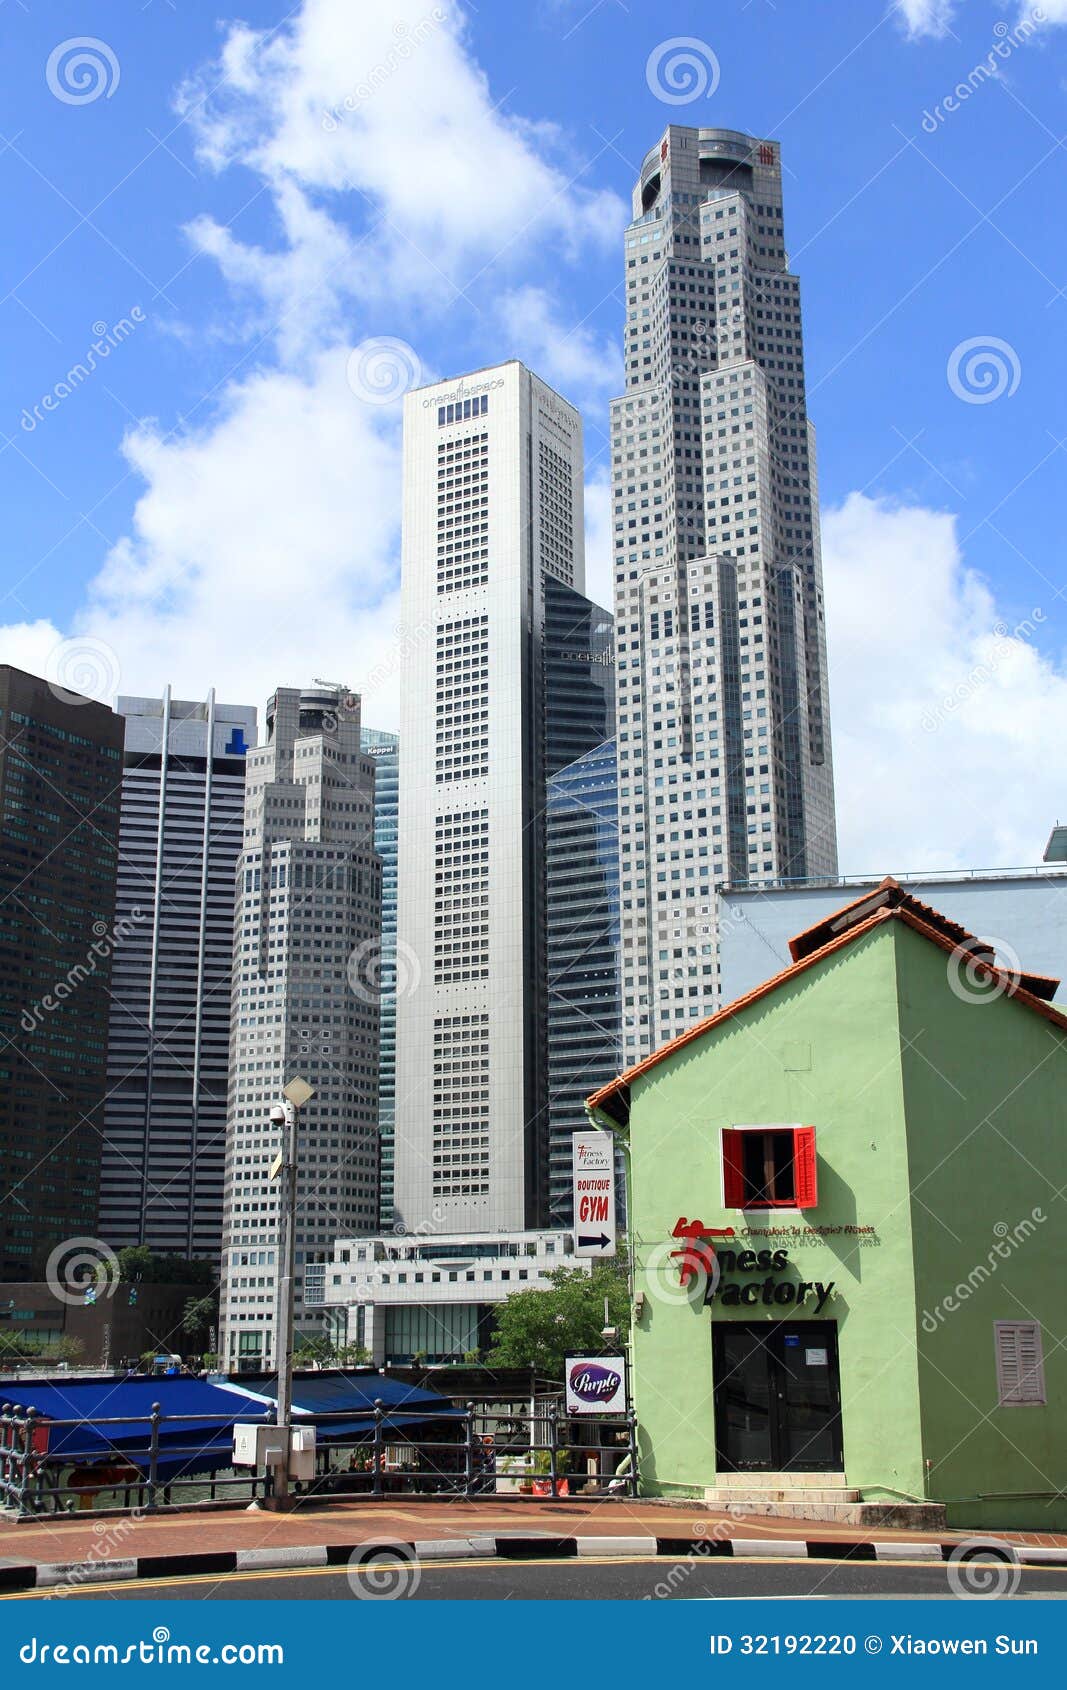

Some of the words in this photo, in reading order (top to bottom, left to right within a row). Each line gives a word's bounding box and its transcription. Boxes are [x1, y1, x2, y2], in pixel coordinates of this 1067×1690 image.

[368, 746, 393, 755] Keppel
[578, 1180, 610, 1191] BOUTIQUE
[579, 1195, 609, 1223] GYM
[703, 1274, 836, 1315] Factory
[574, 1371, 619, 1396] Purple
